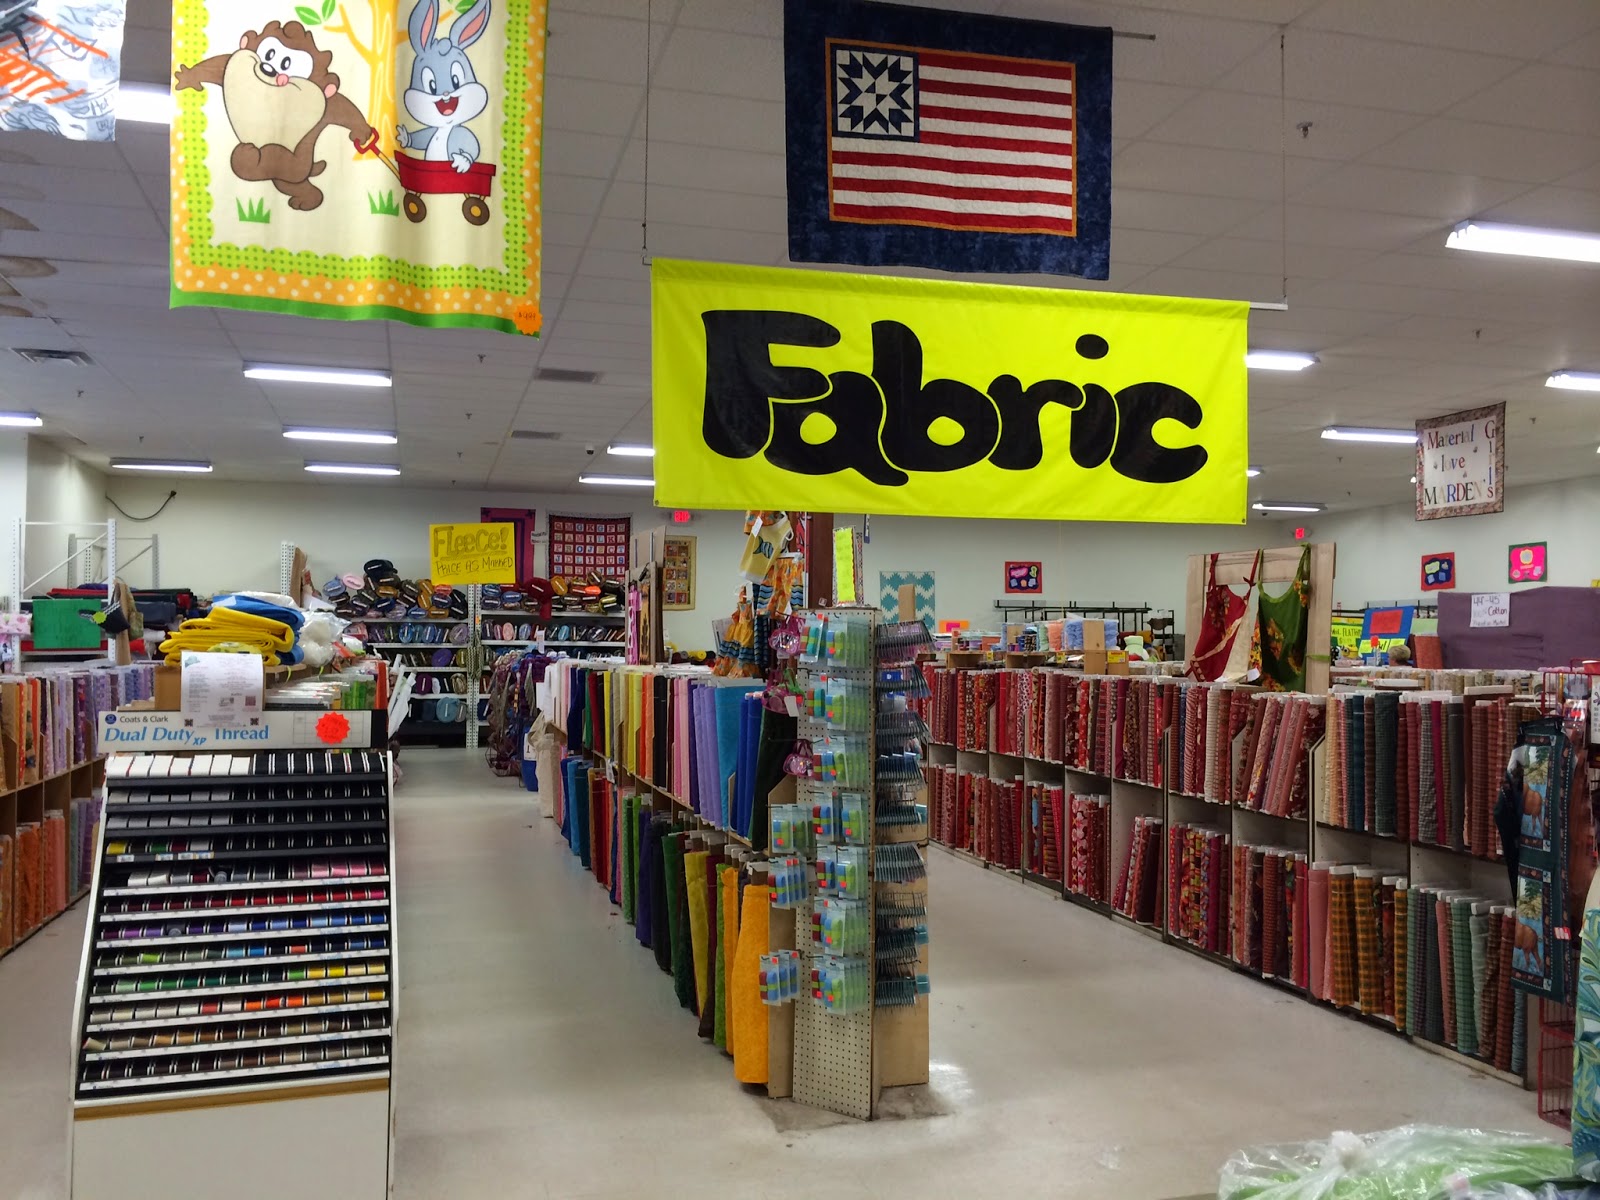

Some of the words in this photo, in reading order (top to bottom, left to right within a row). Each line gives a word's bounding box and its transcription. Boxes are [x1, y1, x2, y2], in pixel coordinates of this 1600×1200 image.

[700, 309, 1208, 487] Fabric
[1487, 605, 1508, 616] Cotton
[119, 715, 141, 723] Coats
[142, 715, 148, 723] &
[149, 715, 168, 723] Clark
[104, 726, 147, 742] Dual
[152, 726, 195, 745] Duty
